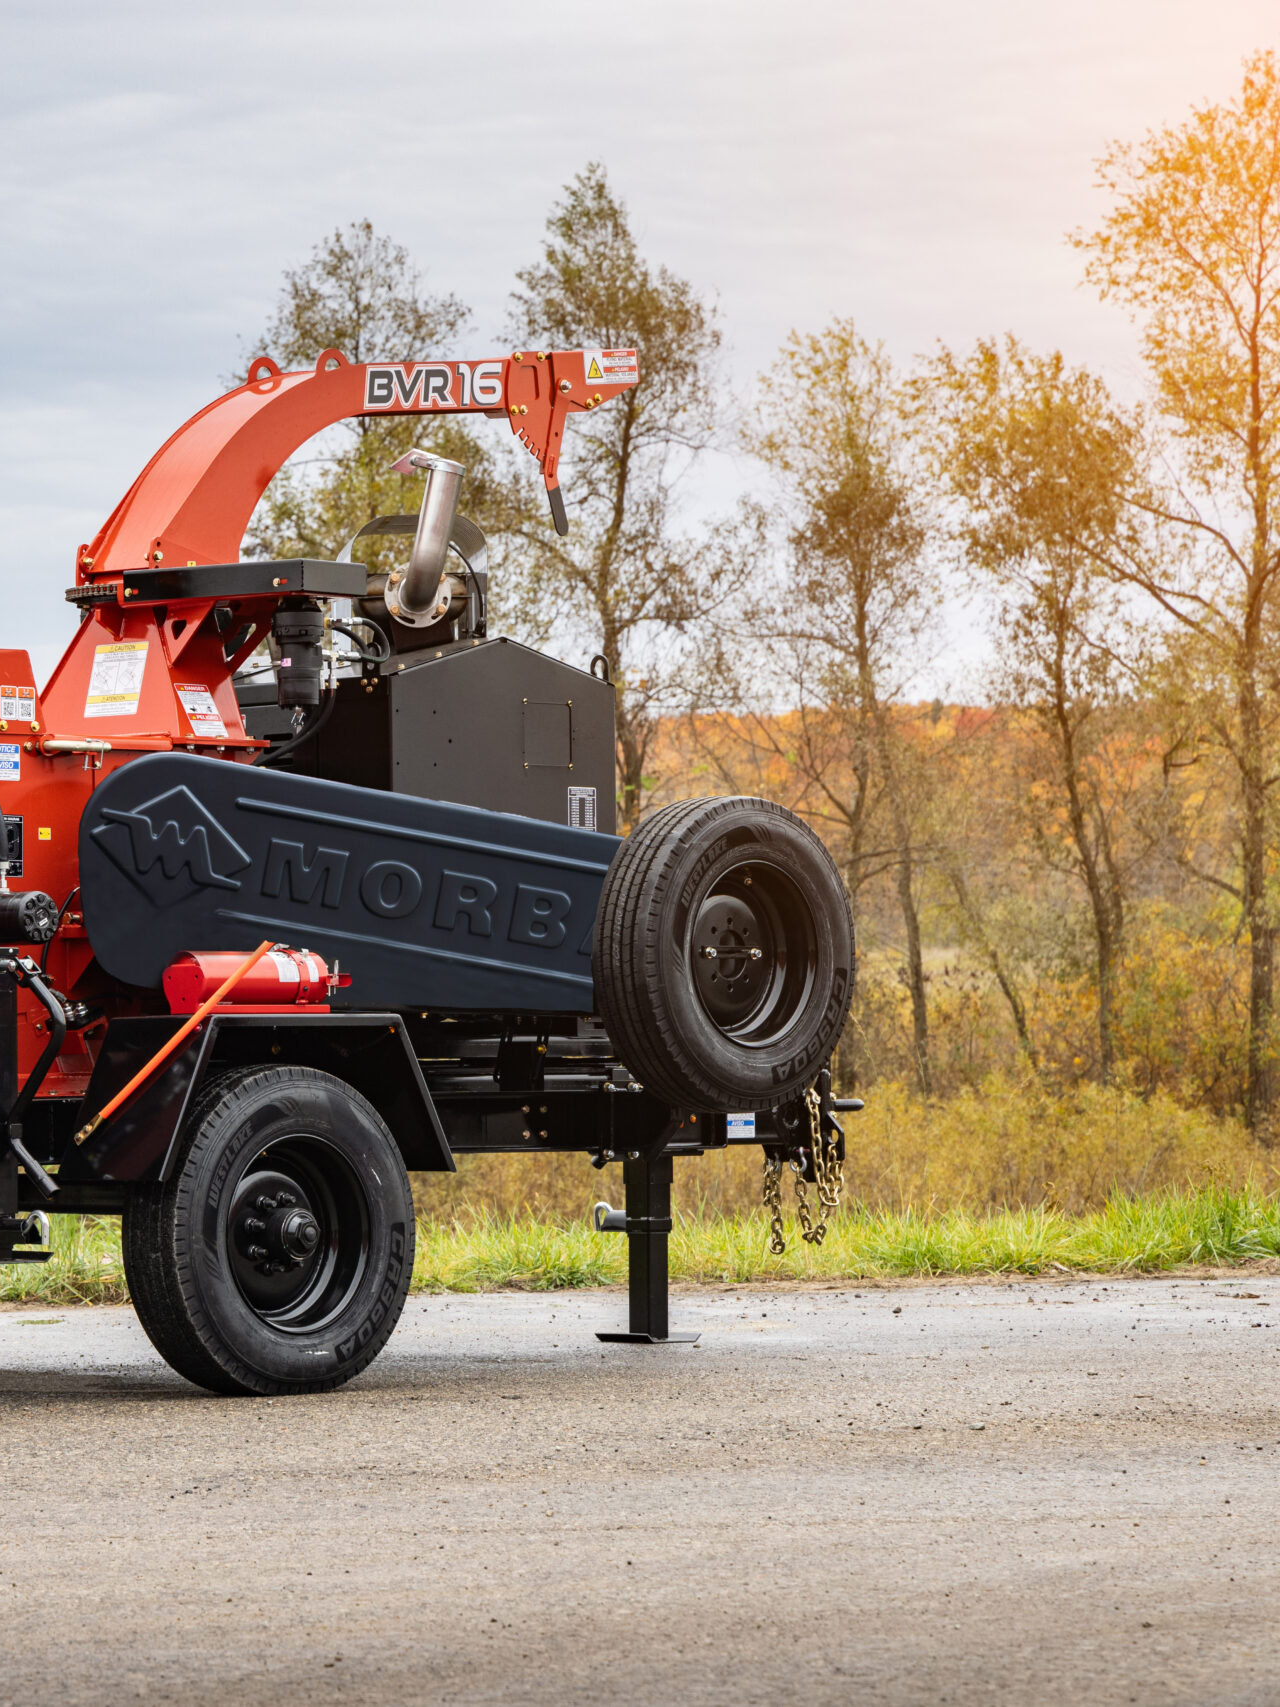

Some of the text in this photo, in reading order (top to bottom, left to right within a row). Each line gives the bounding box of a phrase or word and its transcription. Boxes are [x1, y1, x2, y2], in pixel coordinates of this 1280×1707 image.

[365, 362, 503, 409] BVR 16
[261, 837, 594, 957] MORB
